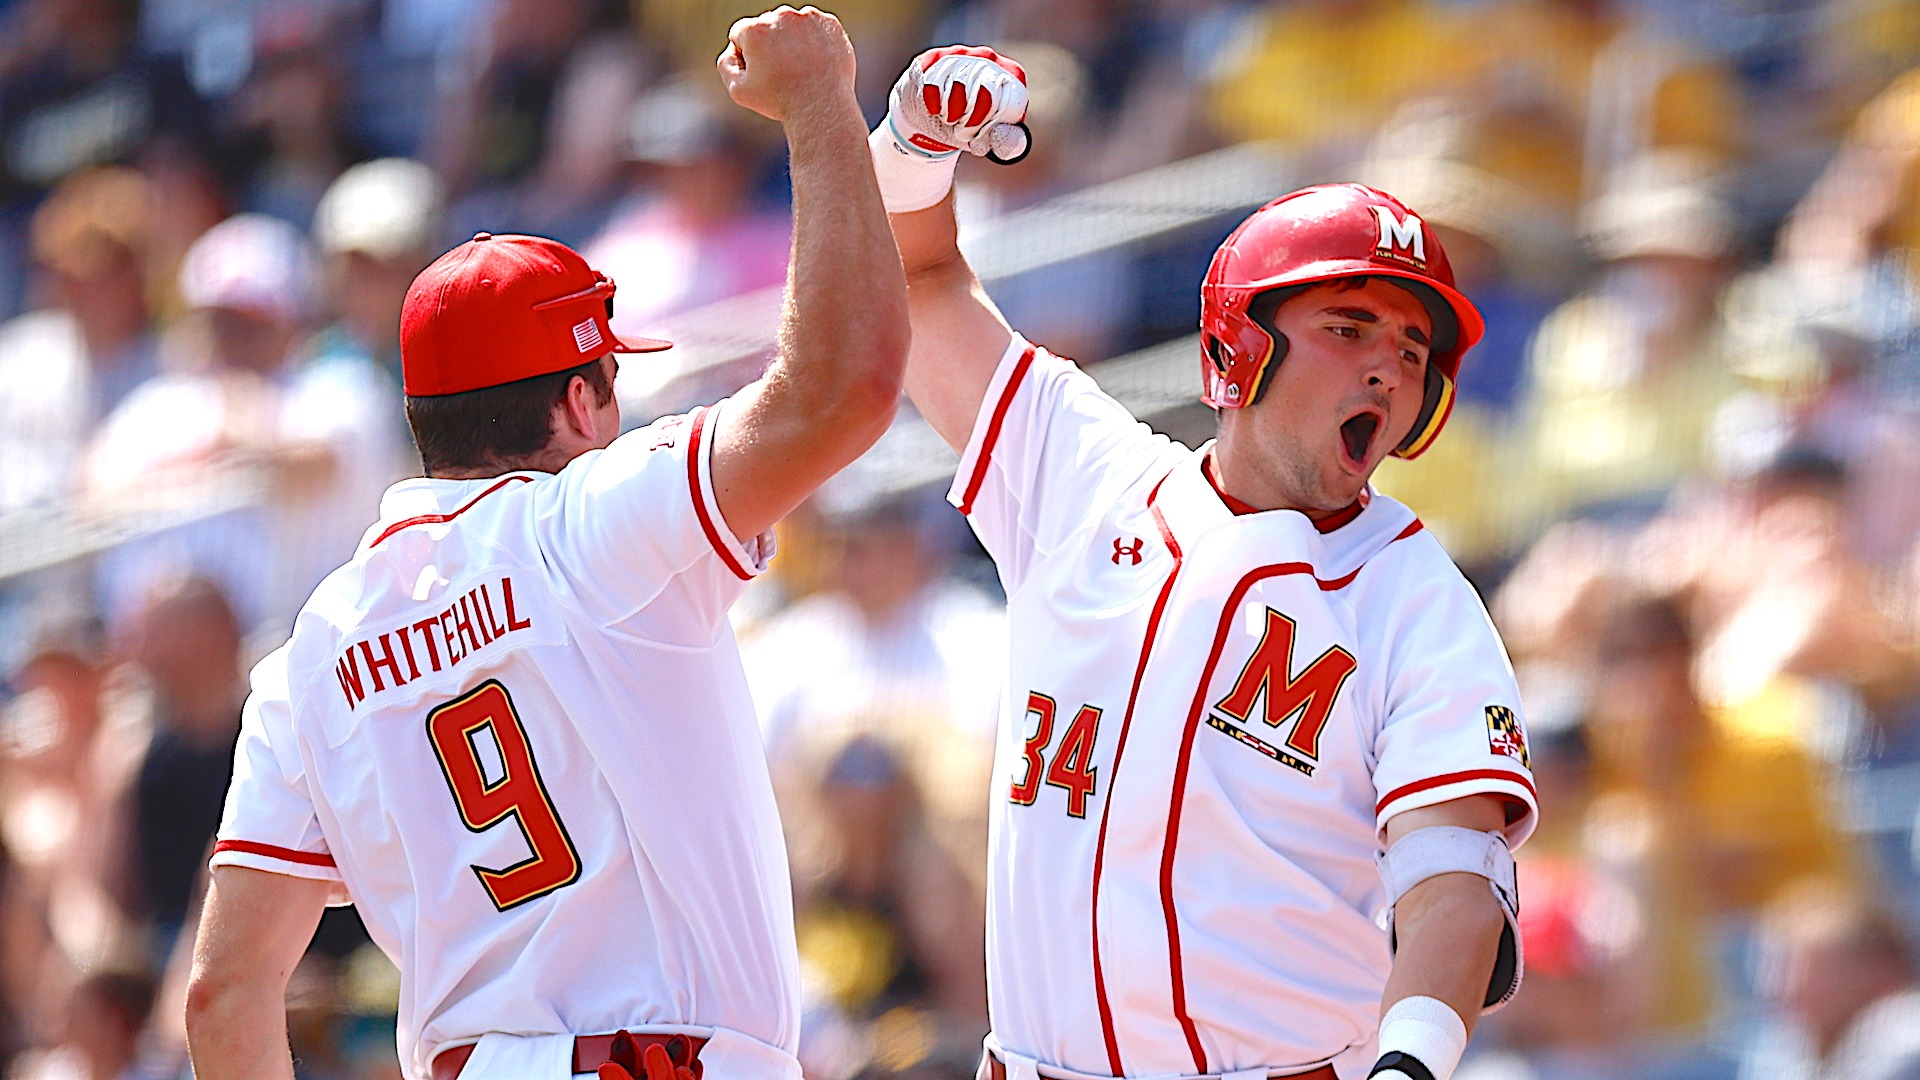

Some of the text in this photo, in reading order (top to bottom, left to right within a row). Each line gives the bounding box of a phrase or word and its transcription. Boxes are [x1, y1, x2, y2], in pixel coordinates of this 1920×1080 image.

[1371, 205, 1427, 263] M
[335, 577, 531, 712] WHITEHILL
[1213, 606, 1357, 761] M
[425, 678, 583, 913] 9
[1009, 690, 1104, 819] 34
